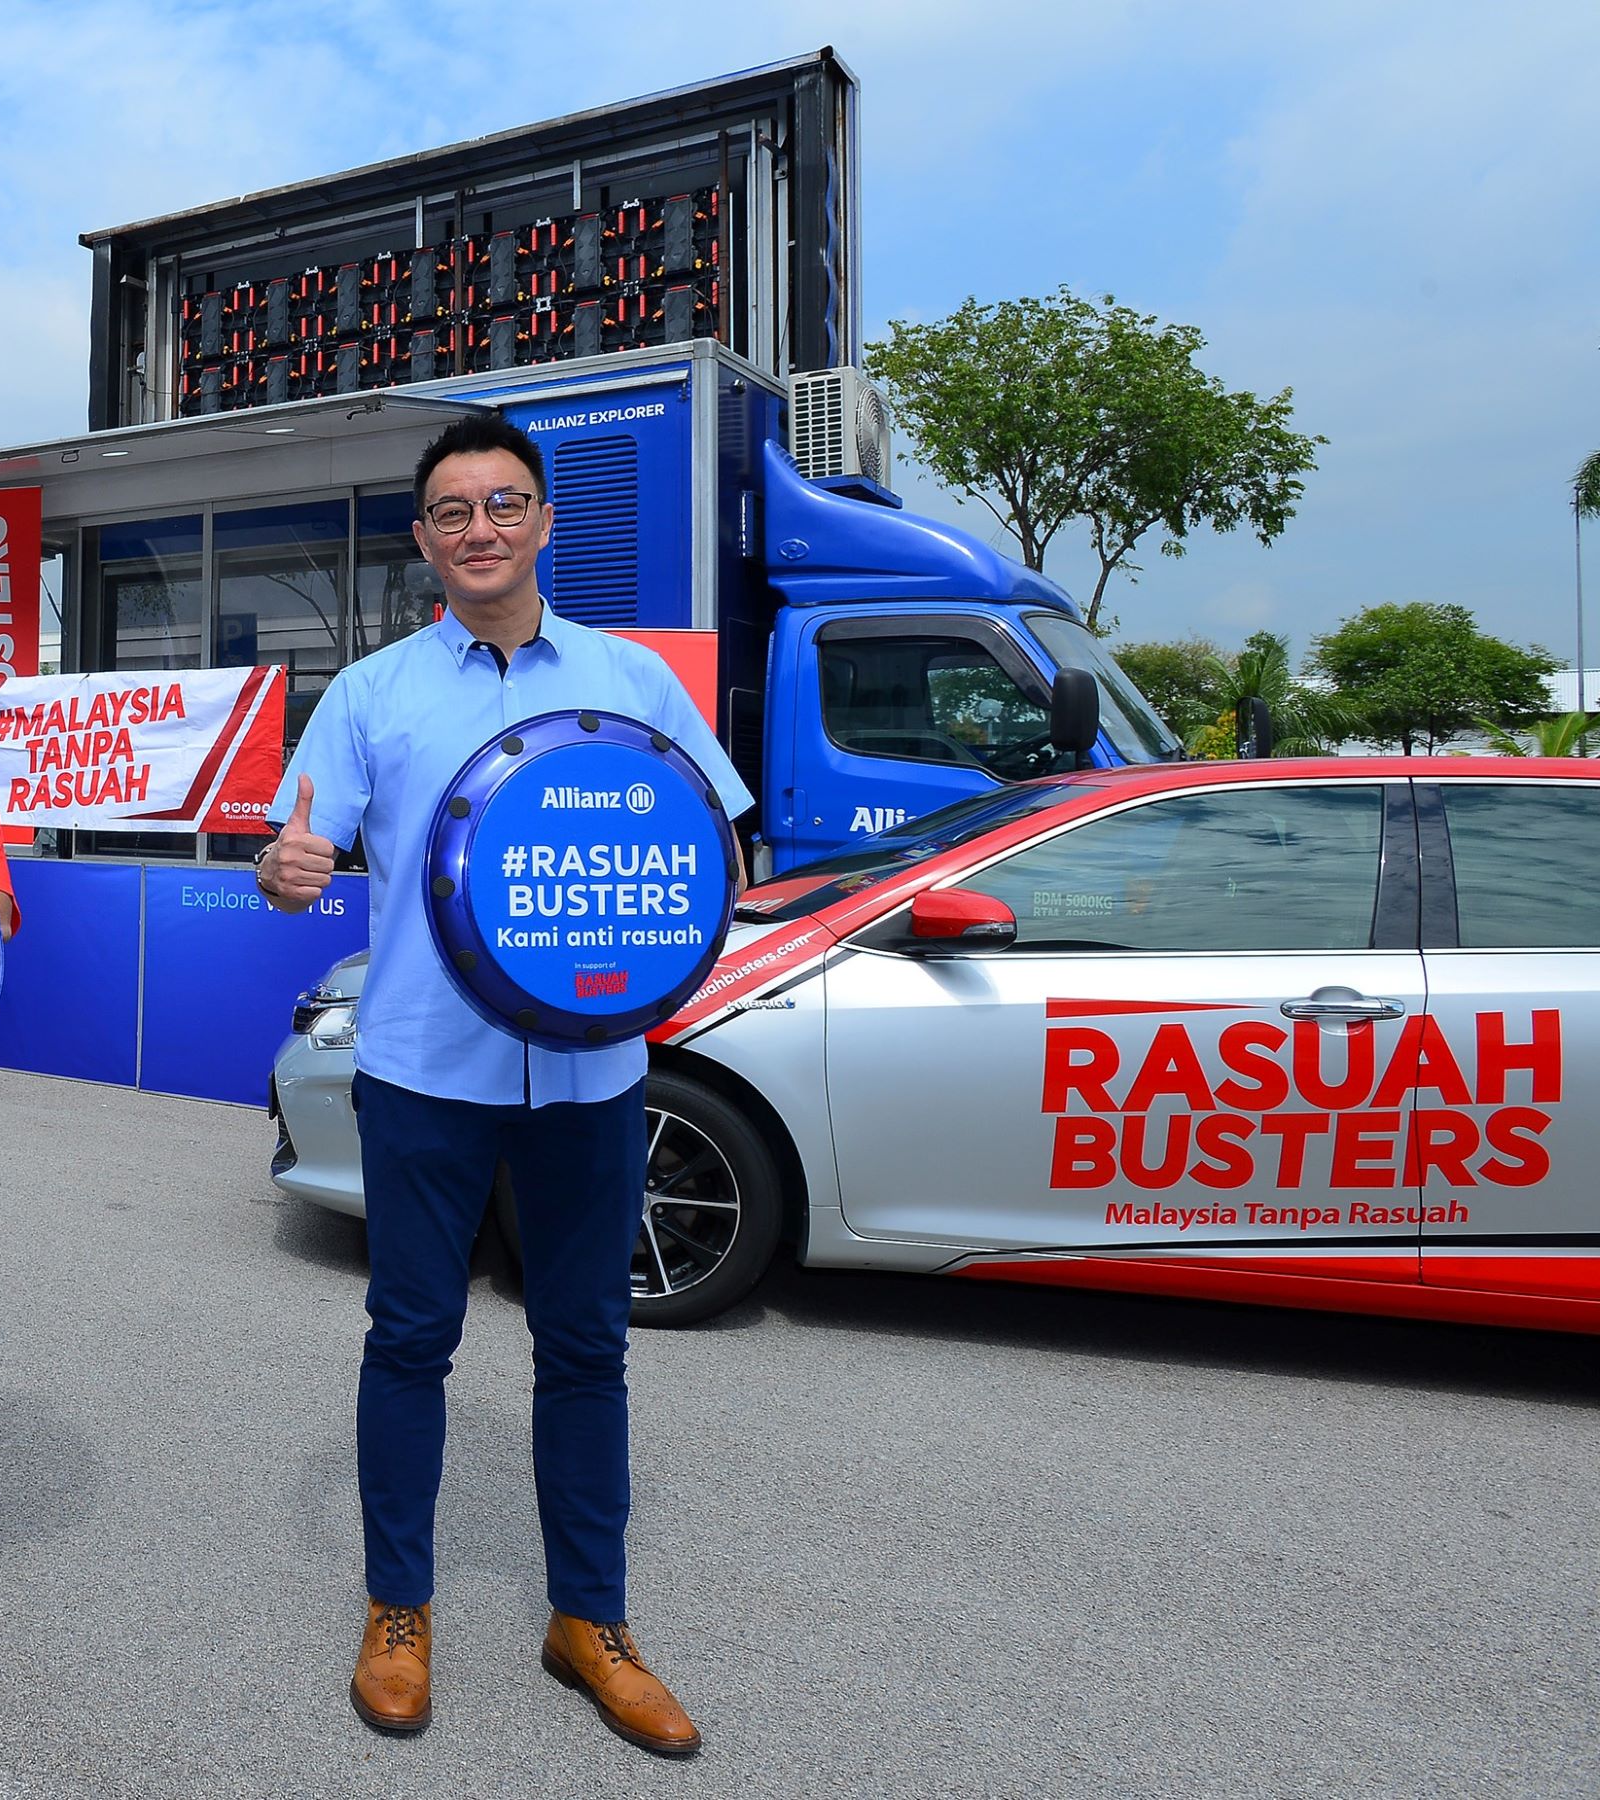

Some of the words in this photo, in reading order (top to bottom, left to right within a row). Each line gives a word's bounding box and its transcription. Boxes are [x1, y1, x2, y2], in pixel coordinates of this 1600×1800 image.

[527, 414, 587, 433] ALLIANZ
[589, 403, 665, 425] EXPLORER
[25, 728, 134, 774] TANPA
[7, 764, 150, 813] RASUAH
[541, 787, 621, 809] Allianz
[849, 806, 918, 833] Alli
[501, 844, 697, 878] #RASUAH
[182, 886, 260, 912] Explore
[319, 897, 345, 916] us
[509, 883, 690, 917] BUSTERS
[1033, 891, 1062, 906] BDM
[1065, 894, 1113, 910] 5000KG
[497, 926, 559, 948] Kami
[566, 925, 614, 946] anti
[622, 924, 702, 946] rasuah
[576, 972, 628, 988] RASUAH
[582, 963, 608, 971] support
[609, 961, 616, 969] of
[677, 933, 810, 1014] suahbusters.com
[576, 984, 627, 999] BUSTERS
[1041, 1008, 1562, 1113] RASUAH
[1049, 1107, 1553, 1190] BUSTERS
[1105, 1202, 1238, 1231] Malaysia
[1244, 1202, 1340, 1231] Tanpa
[1348, 1200, 1469, 1226] Rasuah
